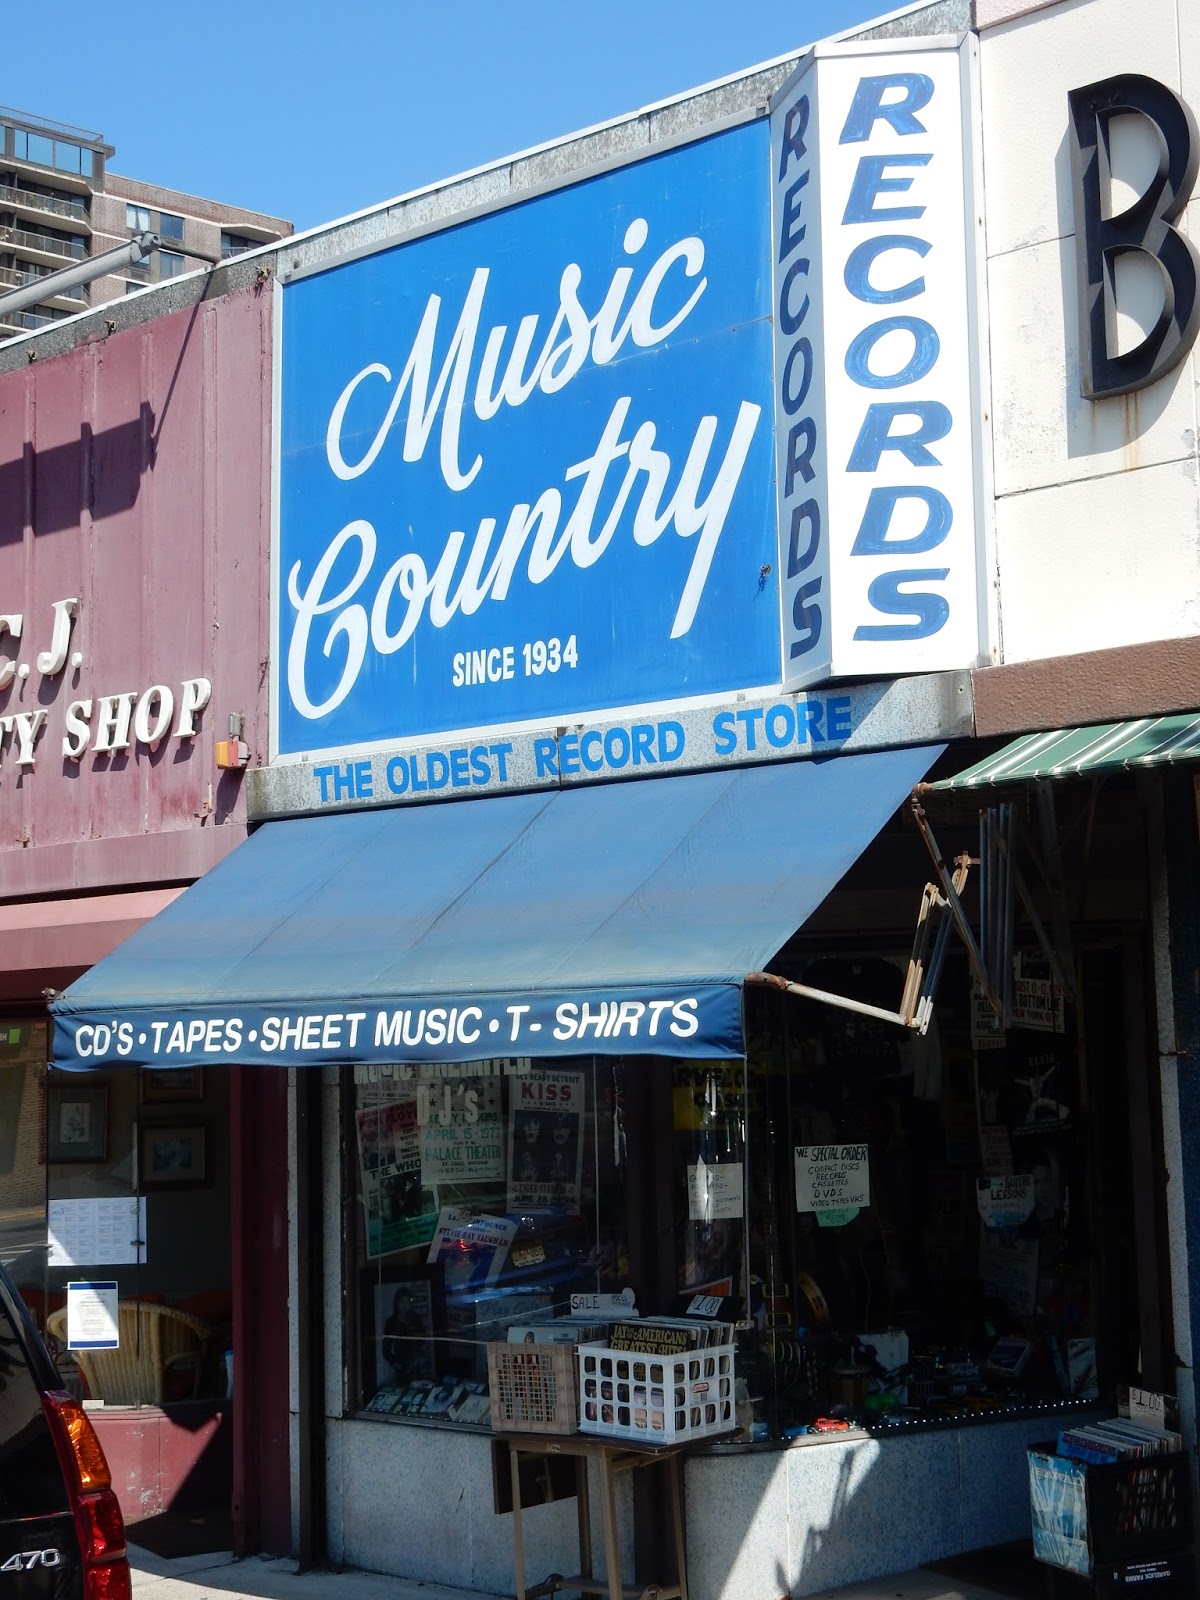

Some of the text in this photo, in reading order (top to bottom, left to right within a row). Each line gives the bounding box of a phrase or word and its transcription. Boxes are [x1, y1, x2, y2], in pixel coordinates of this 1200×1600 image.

[1069, 73, 1199, 398] B
[327, 218, 708, 491] Music
[839, 72, 953, 641] RECORDS
[778, 94, 822, 660] RECORDS
[287, 396, 762, 719] Country
[452, 634, 578, 687] SINCE 1934
[62, 678, 212, 758] SHOP
[314, 696, 851, 802] THE OLDEST RECORD STORE
[75, 1020, 133, 1057] CD'S
[151, 1018, 244, 1054] TAPES
[259, 1012, 367, 1052] SHEET
[374, 1005, 483, 1047] MUSIC
[552, 998, 699, 1041] SHIRTS
[521, 1082, 572, 1102] KISS
[426, 1128, 459, 1141] APRIL
[480, 1126, 501, 1140] 1977
[425, 1144, 502, 1162] PALACE THEATER
[796, 1146, 867, 1162] WE SPECIAL ORDER
[395, 1157, 422, 1173] WHO
[808, 1164, 838, 1174] COMPACT
[812, 1179, 849, 1188] CASSETTES
[816, 1171, 847, 1181] RECORDS
[810, 1199, 830, 1207] VIDEO
[850, 1194, 865, 1203] VHS
[991, 1187, 1028, 1200] LESSONS
[438, 1227, 460, 1238] STEVIE
[462, 1230, 475, 1241] RAY
[571, 1295, 600, 1310] SALE
[611, 1325, 628, 1341] JAY
[633, 1327, 689, 1346] AMERICANS
[611, 1339, 658, 1354] GREATEST
[0, 1547, 61, 1572] 470
